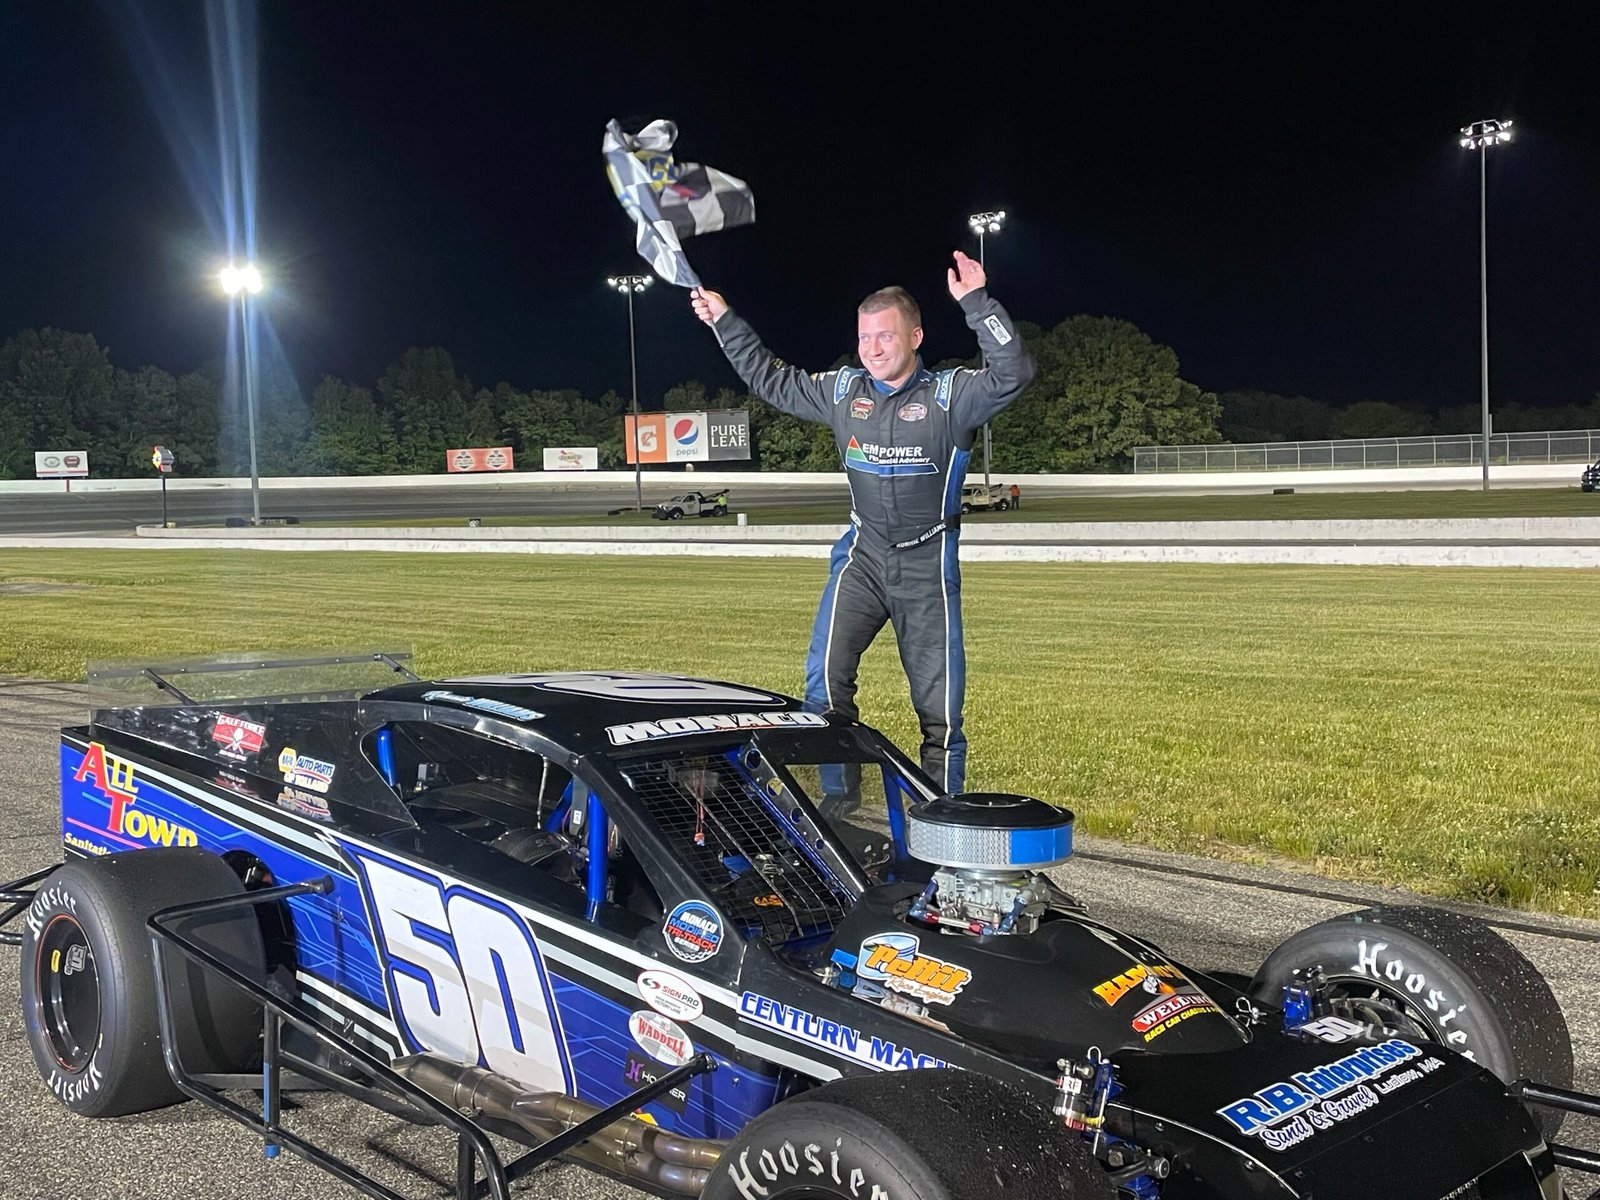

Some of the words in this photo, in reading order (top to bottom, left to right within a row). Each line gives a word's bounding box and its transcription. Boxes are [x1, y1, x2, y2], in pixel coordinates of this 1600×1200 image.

[710, 424, 746, 436] PURE
[676, 448, 698, 456] pepsi
[862, 443, 923, 457] EMPOWER
[868, 455, 899, 464] Financial
[609, 712, 827, 744] MONACO
[297, 757, 314, 770] AUTO
[313, 761, 334, 776] PARTS
[27, 881, 77, 941] Hoosier
[680, 911, 718, 934] MONACO
[668, 925, 716, 951] TRI-TRACK
[357, 853, 568, 1095] 50
[865, 943, 970, 993] Pettit
[662, 985, 683, 999] SIGN
[681, 994, 700, 1007] PRO
[740, 990, 861, 1052] CENTURN
[1143, 1024, 1166, 1043] RACE
[1165, 1015, 1182, 1028] CAR
[1301, 1016, 1365, 1043] 50
[637, 1017, 685, 1059] WADDELL
[1220, 1083, 1317, 1132] R.B.
[1294, 1039, 1420, 1097] Enterprises
[1261, 1118, 1312, 1149] Sand
[1309, 1110, 1331, 1127] &
[1321, 1085, 1377, 1121] Gravel
[1417, 1057, 1446, 1074] MA
